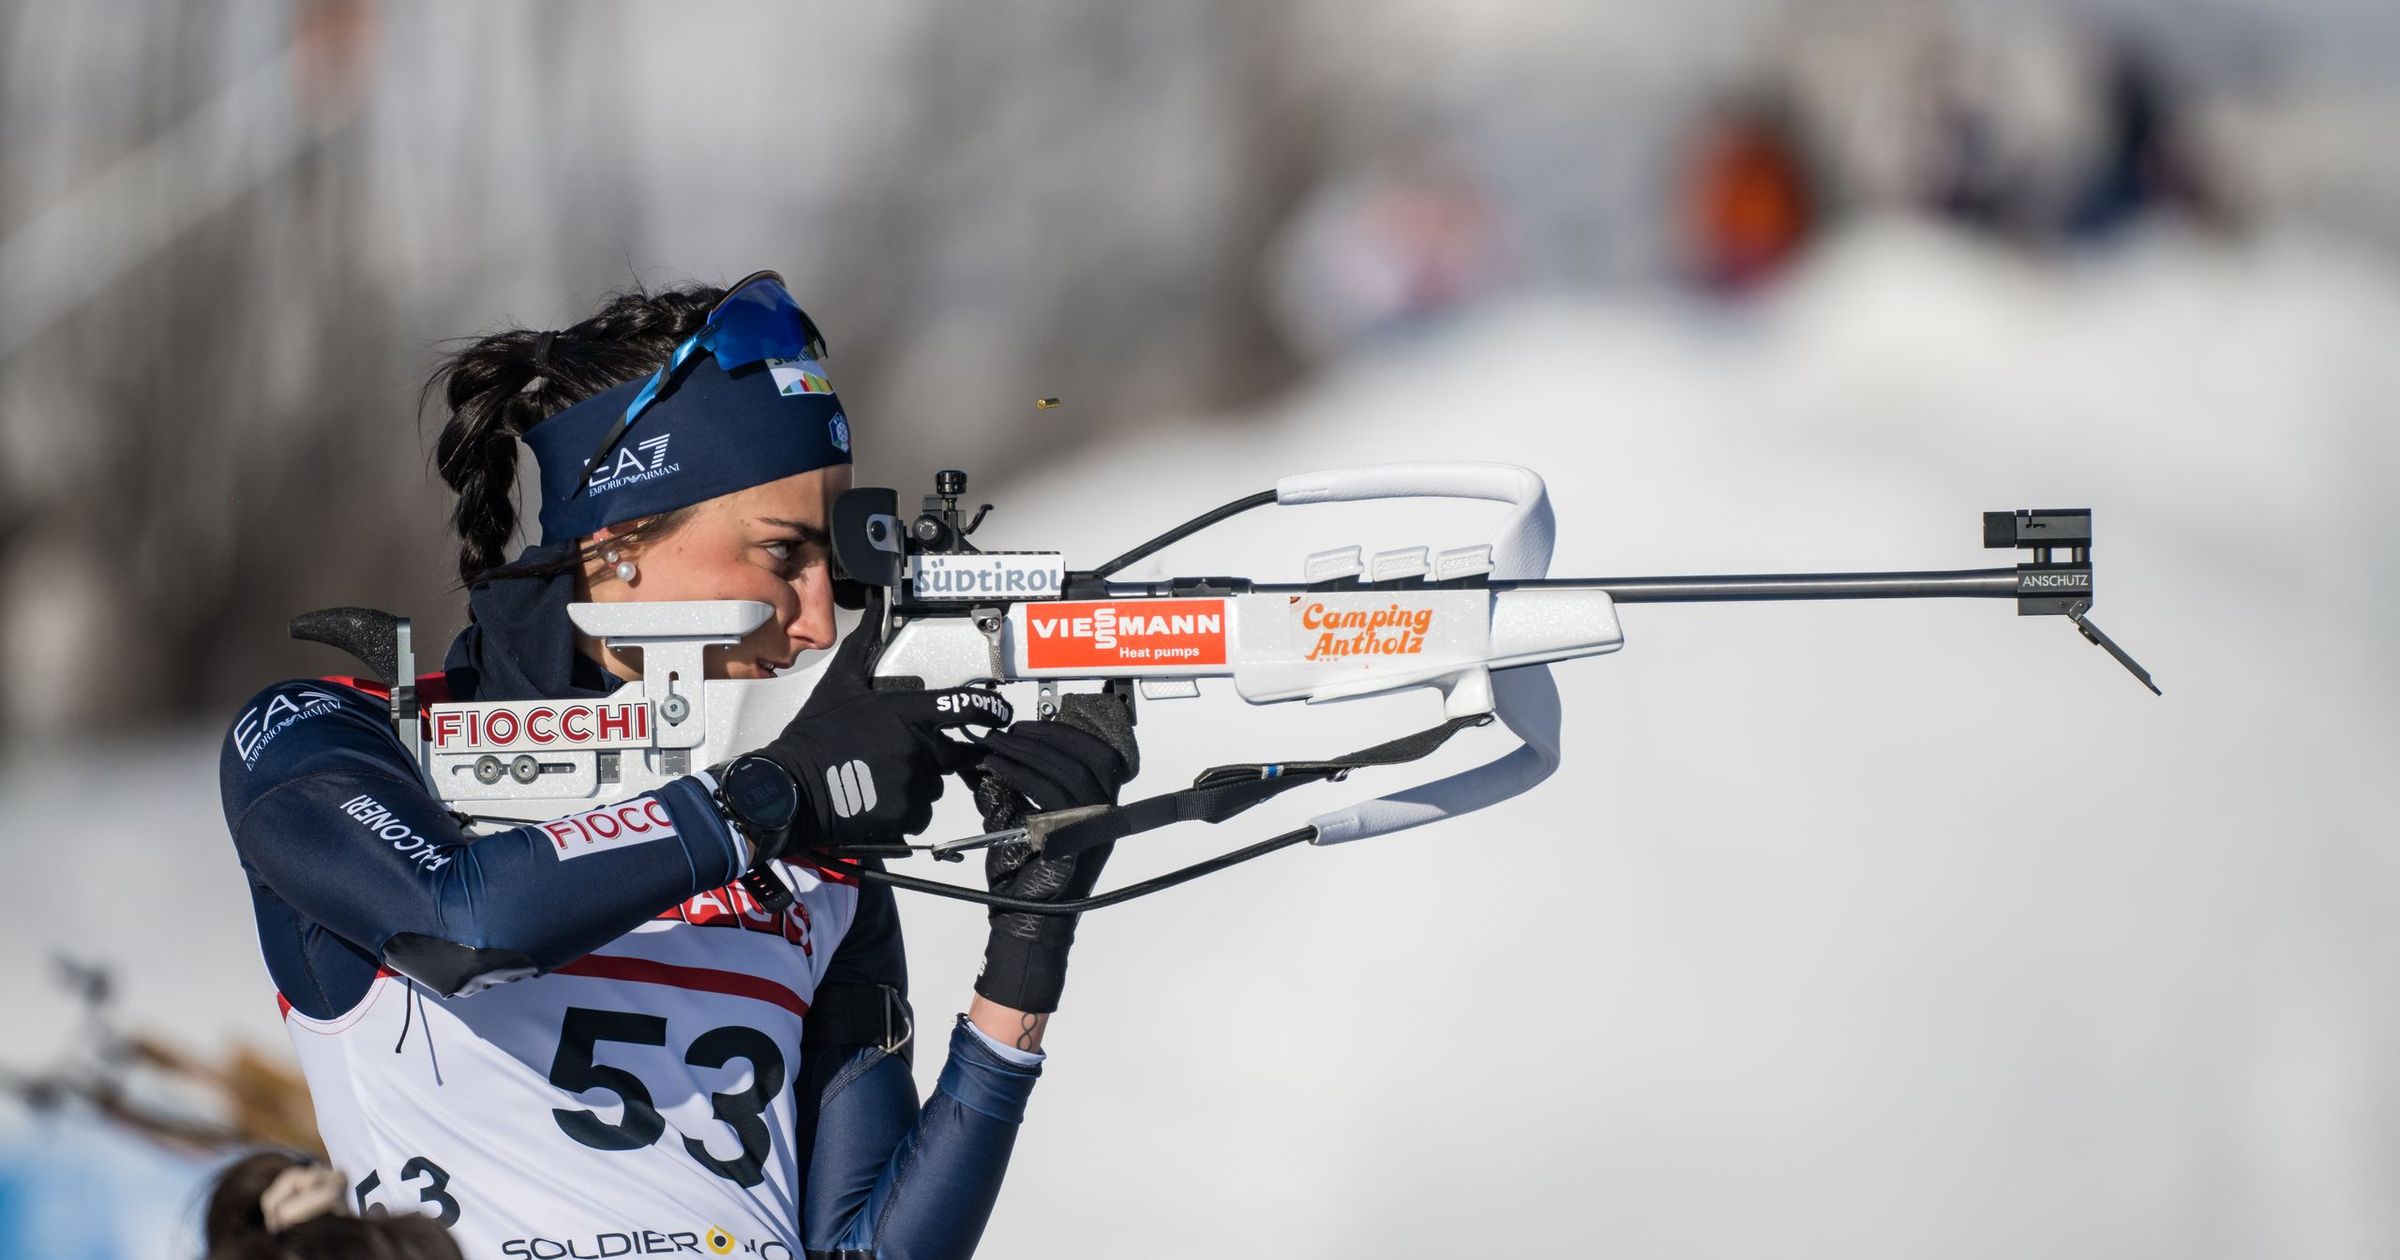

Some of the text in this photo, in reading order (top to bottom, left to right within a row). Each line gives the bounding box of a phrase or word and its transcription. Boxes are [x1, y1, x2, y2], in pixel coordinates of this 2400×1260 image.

[589, 463, 681, 498] EMPORIO ARMANI
[1031, 607, 1220, 650] VIESSMANN
[1303, 603, 1433, 636] Camping
[1119, 647, 1200, 660] Heat pumps
[1304, 630, 1425, 661] Antholz
[246, 700, 341, 772] EMPORIO ARMANI
[433, 703, 650, 750] FIOCCHI
[543, 800, 673, 850] FIOCC
[549, 1006, 786, 1190] 53
[501, 1229, 704, 1260] SOLDIER
